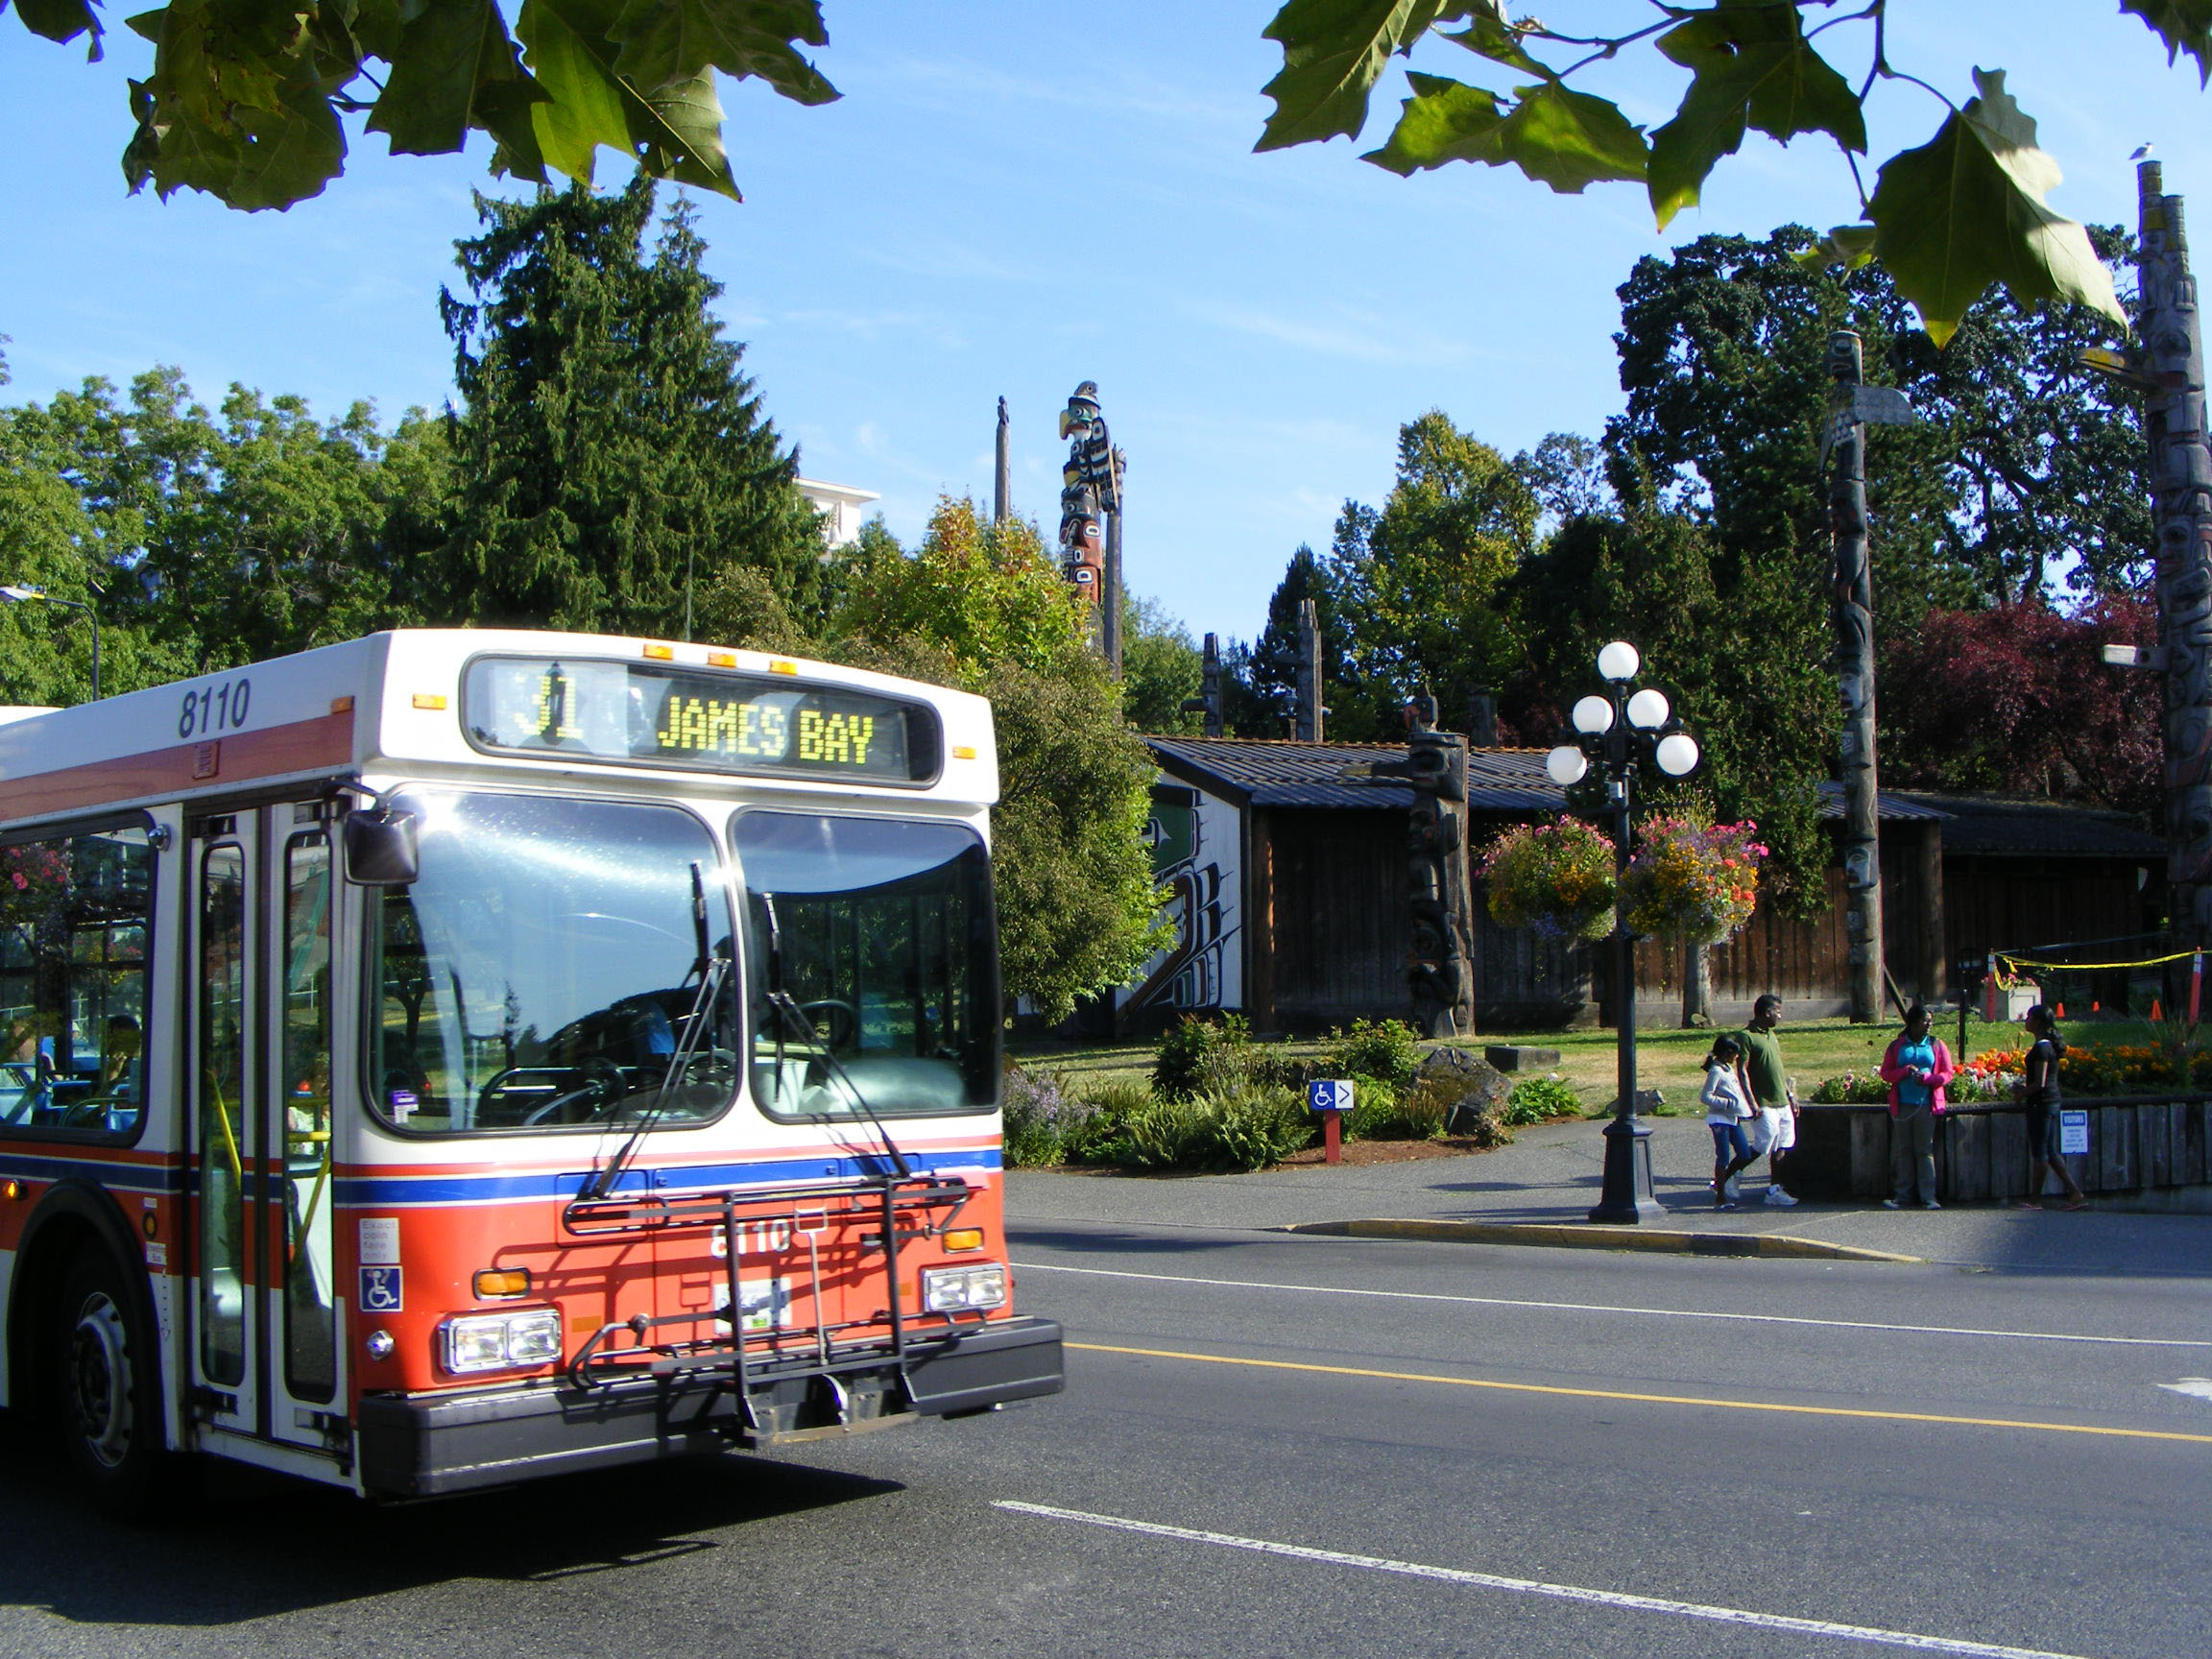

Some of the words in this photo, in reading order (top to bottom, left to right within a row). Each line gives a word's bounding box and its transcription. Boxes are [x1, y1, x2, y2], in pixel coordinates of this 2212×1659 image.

[180, 679, 251, 738] 8110
[659, 696, 785, 757] JAMES
[799, 709, 875, 765] BAY
[363, 1221, 395, 1230] Exact
